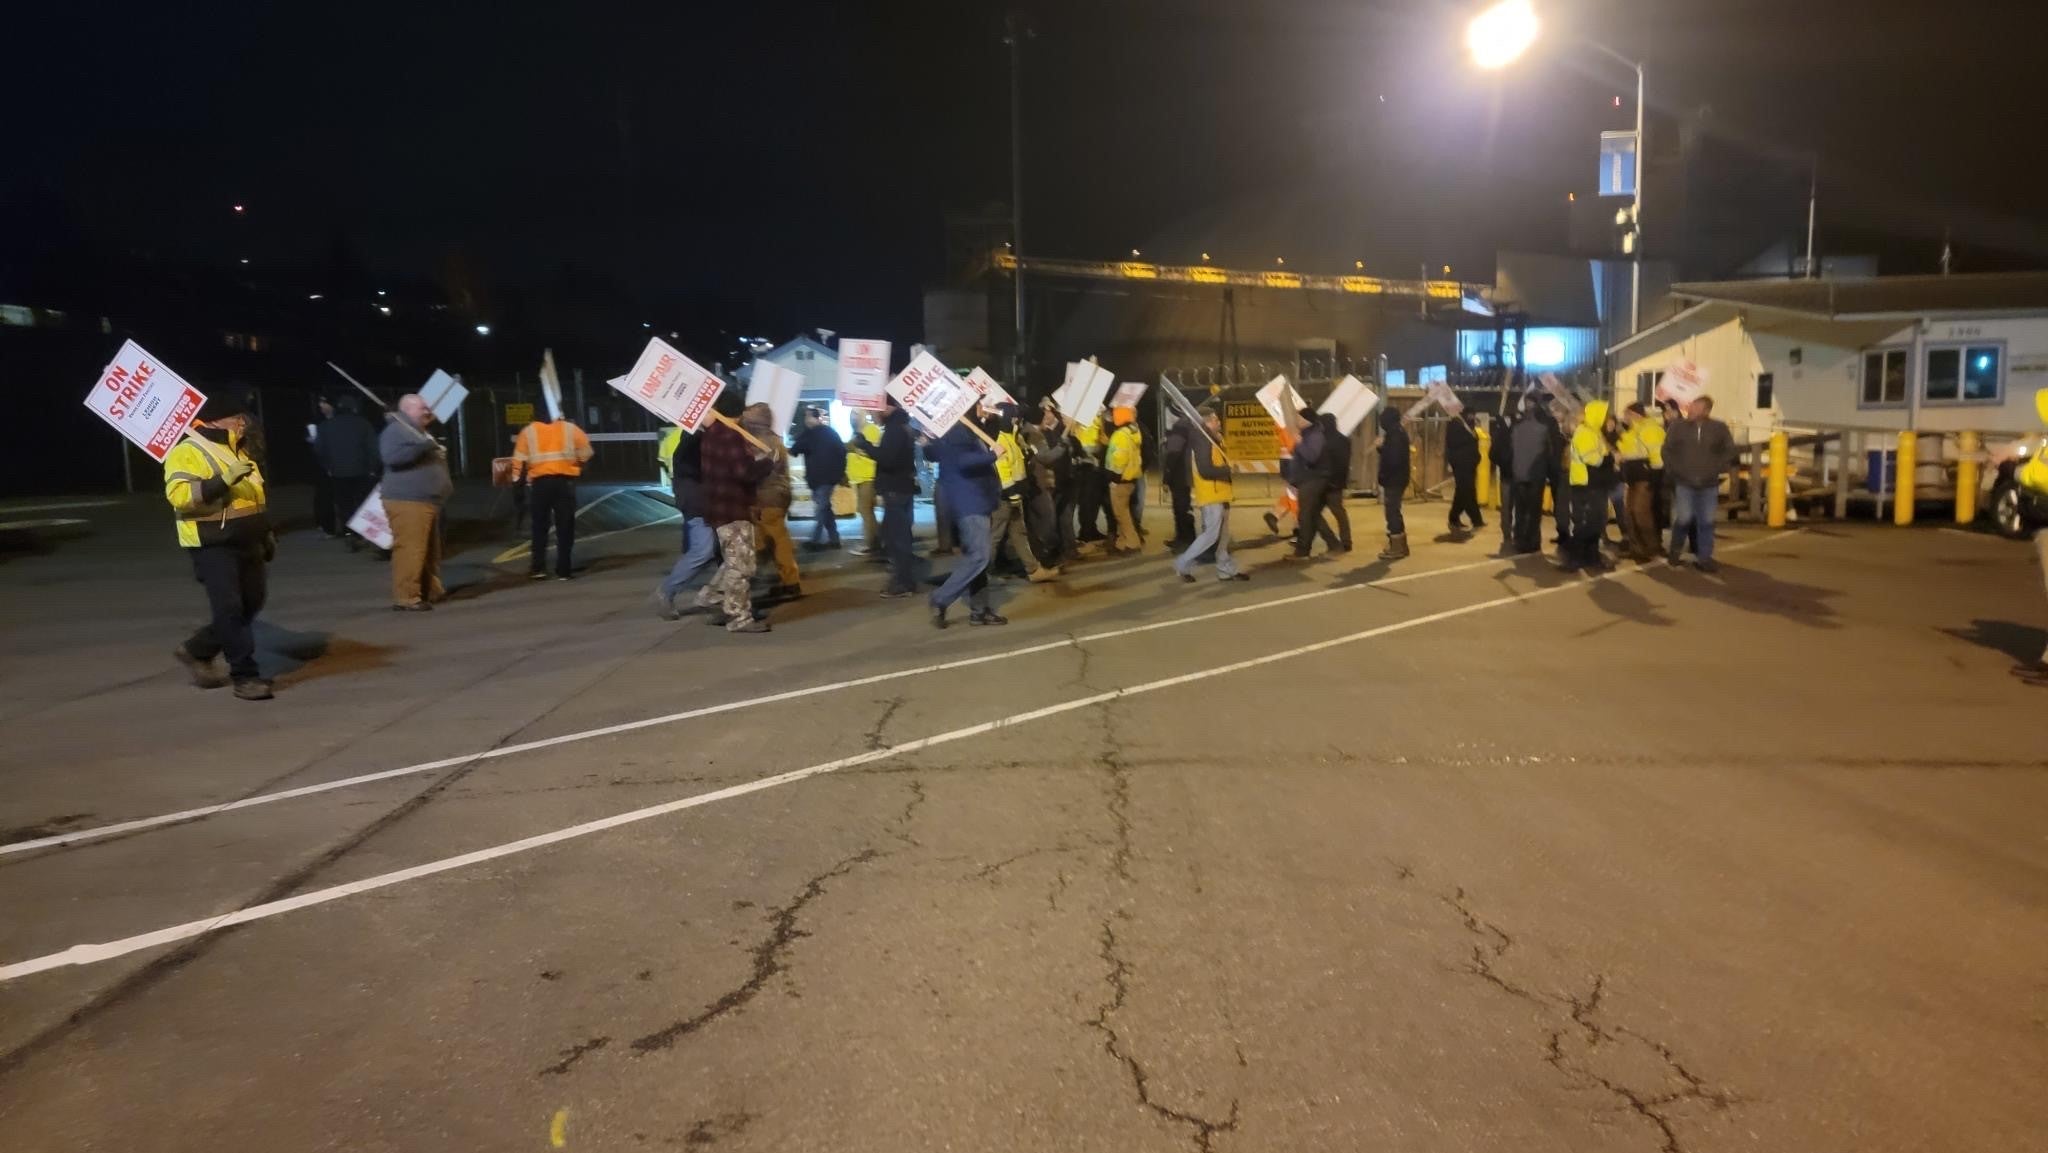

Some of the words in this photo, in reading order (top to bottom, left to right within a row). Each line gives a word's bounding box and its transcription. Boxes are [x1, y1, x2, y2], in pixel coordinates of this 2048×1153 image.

[105, 365, 129, 392] ON
[109, 360, 156, 421] STRIKE
[640, 354, 677, 399] UNFAIR
[902, 367, 924, 388] ON
[903, 364, 945, 407] STRIKE
[151, 395, 191, 447] TEAMSTERS
[159, 421, 183, 450] LOCAL
[180, 401, 196, 420] 174
[688, 400, 706, 423] LOCAL
